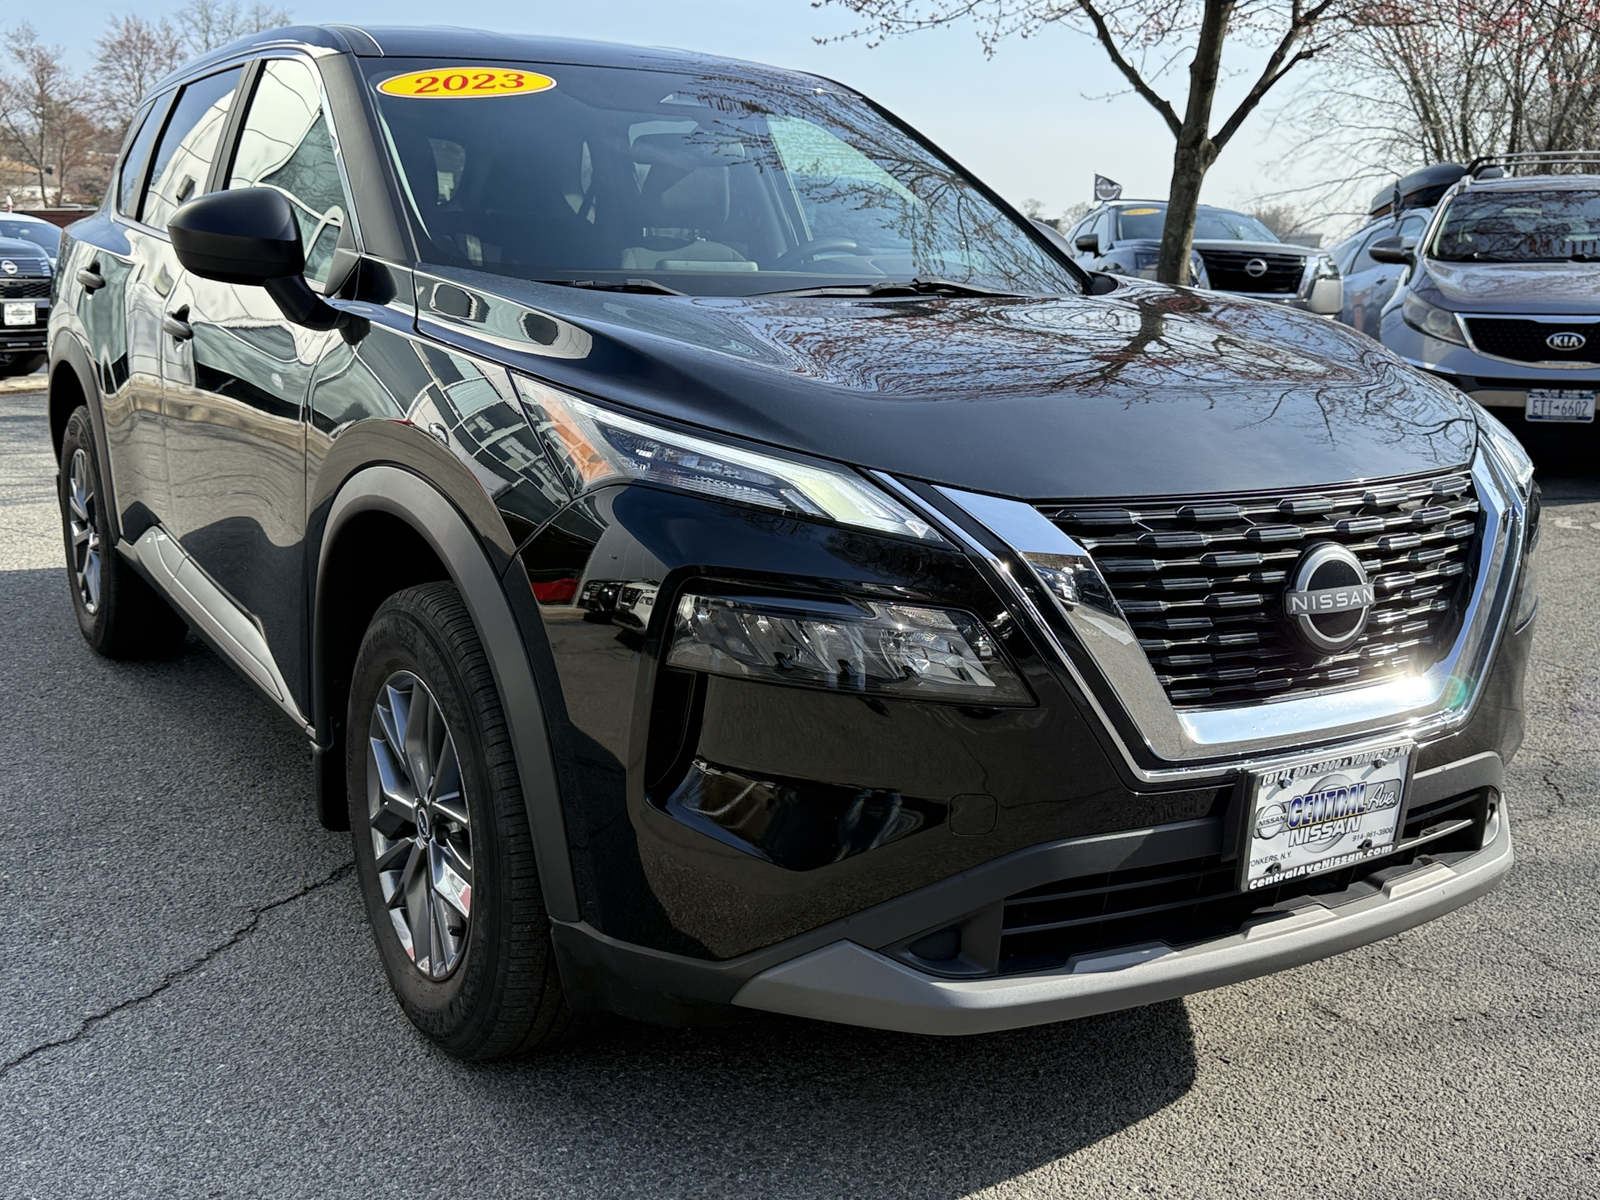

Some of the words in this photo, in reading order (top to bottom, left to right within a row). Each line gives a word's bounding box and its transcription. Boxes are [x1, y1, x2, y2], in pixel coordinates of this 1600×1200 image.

[414, 73, 525, 94] 2023
[1553, 336, 1579, 347] KIA
[1291, 587, 1374, 611] NISSAN
[1287, 782, 1367, 829] CENTRAL
[1367, 782, 1396, 810] Ave.
[1258, 815, 1286, 826] NISSAN
[1288, 815, 1362, 848] NISSAN
